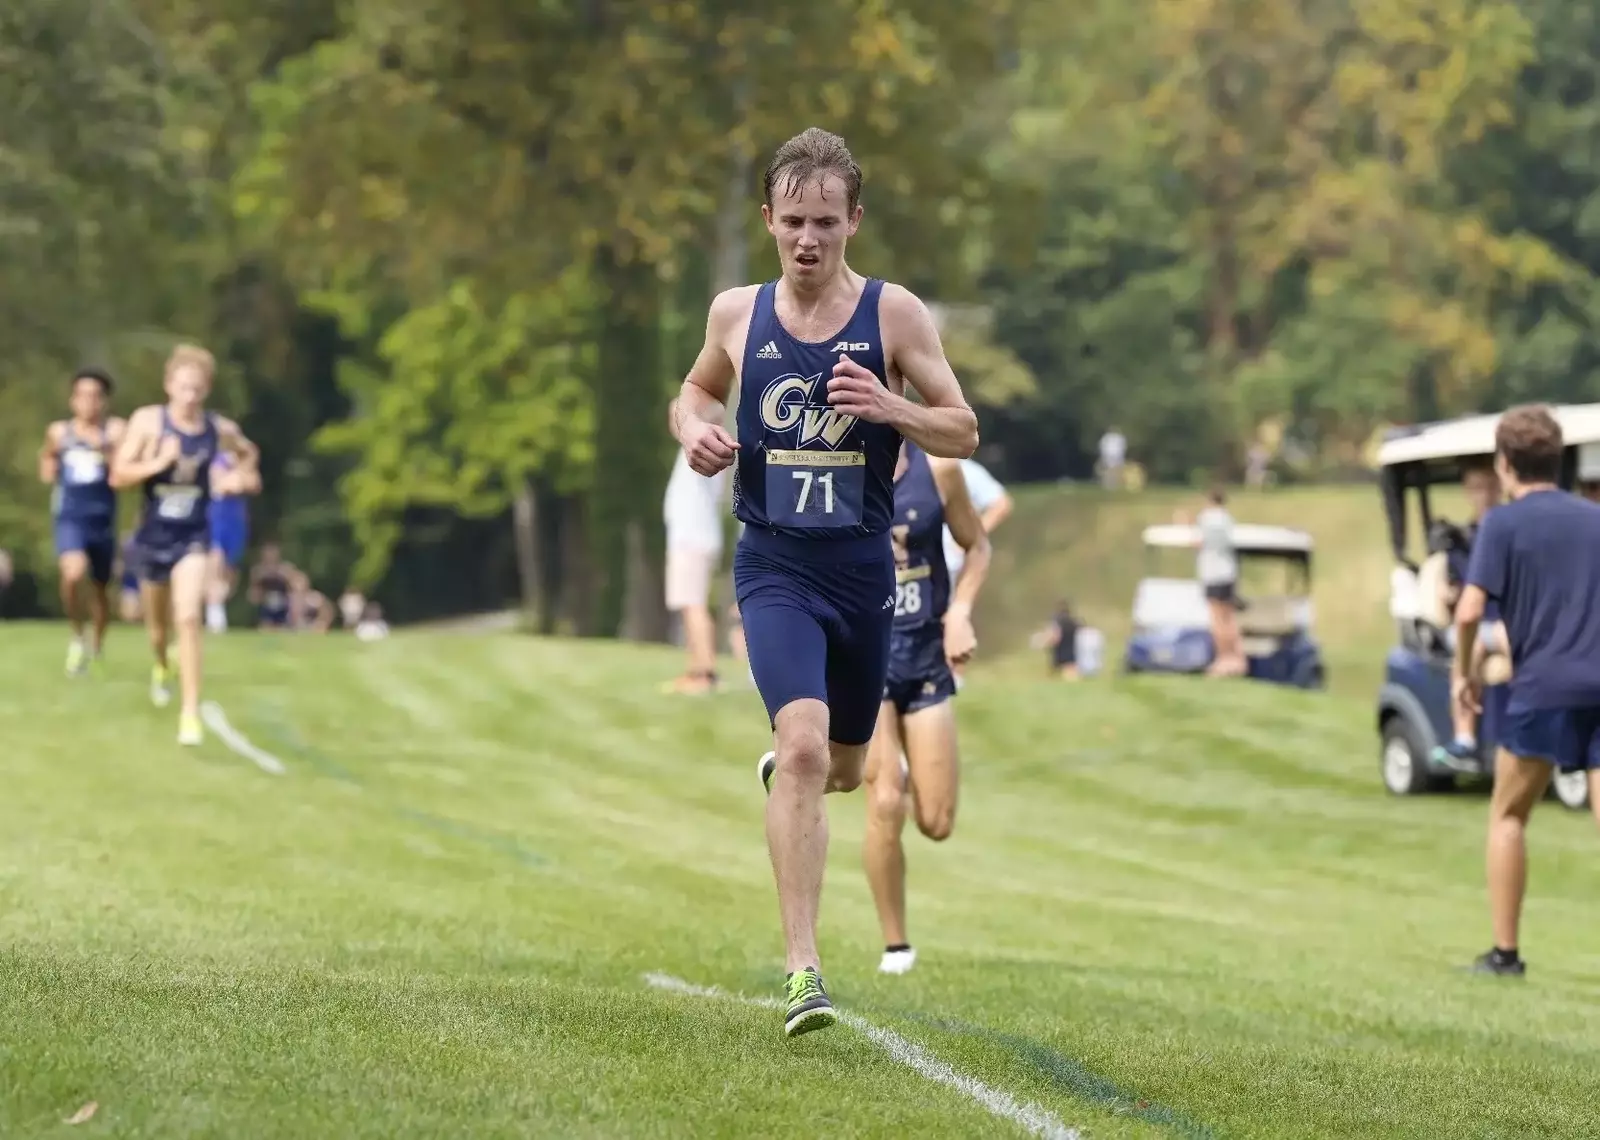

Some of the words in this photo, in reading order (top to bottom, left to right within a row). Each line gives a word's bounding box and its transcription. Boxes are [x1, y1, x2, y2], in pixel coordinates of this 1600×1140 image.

[756, 351, 783, 359] adidas
[829, 341, 870, 353] A10
[759, 372, 860, 451] GW
[792, 471, 834, 513] 71
[894, 581, 922, 617] 28
